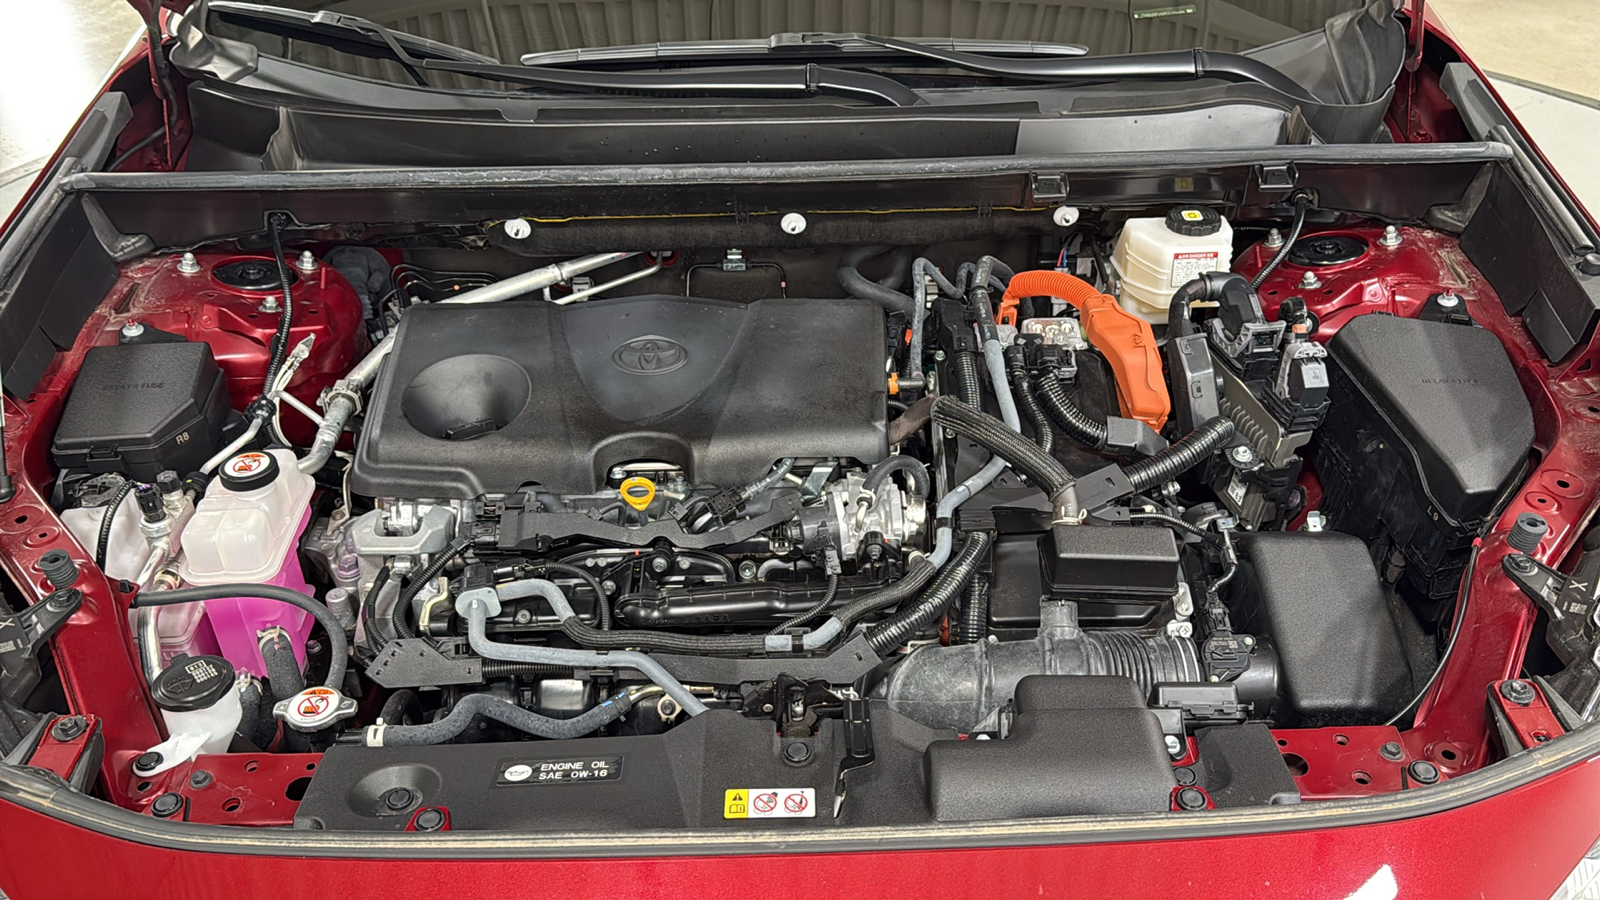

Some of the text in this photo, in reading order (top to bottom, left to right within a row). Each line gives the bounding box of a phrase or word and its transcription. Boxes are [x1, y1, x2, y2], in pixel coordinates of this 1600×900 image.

[175, 432, 190, 446] R8
[540, 760, 610, 771] ENGINE OIL
[538, 771, 564, 780] SAE
